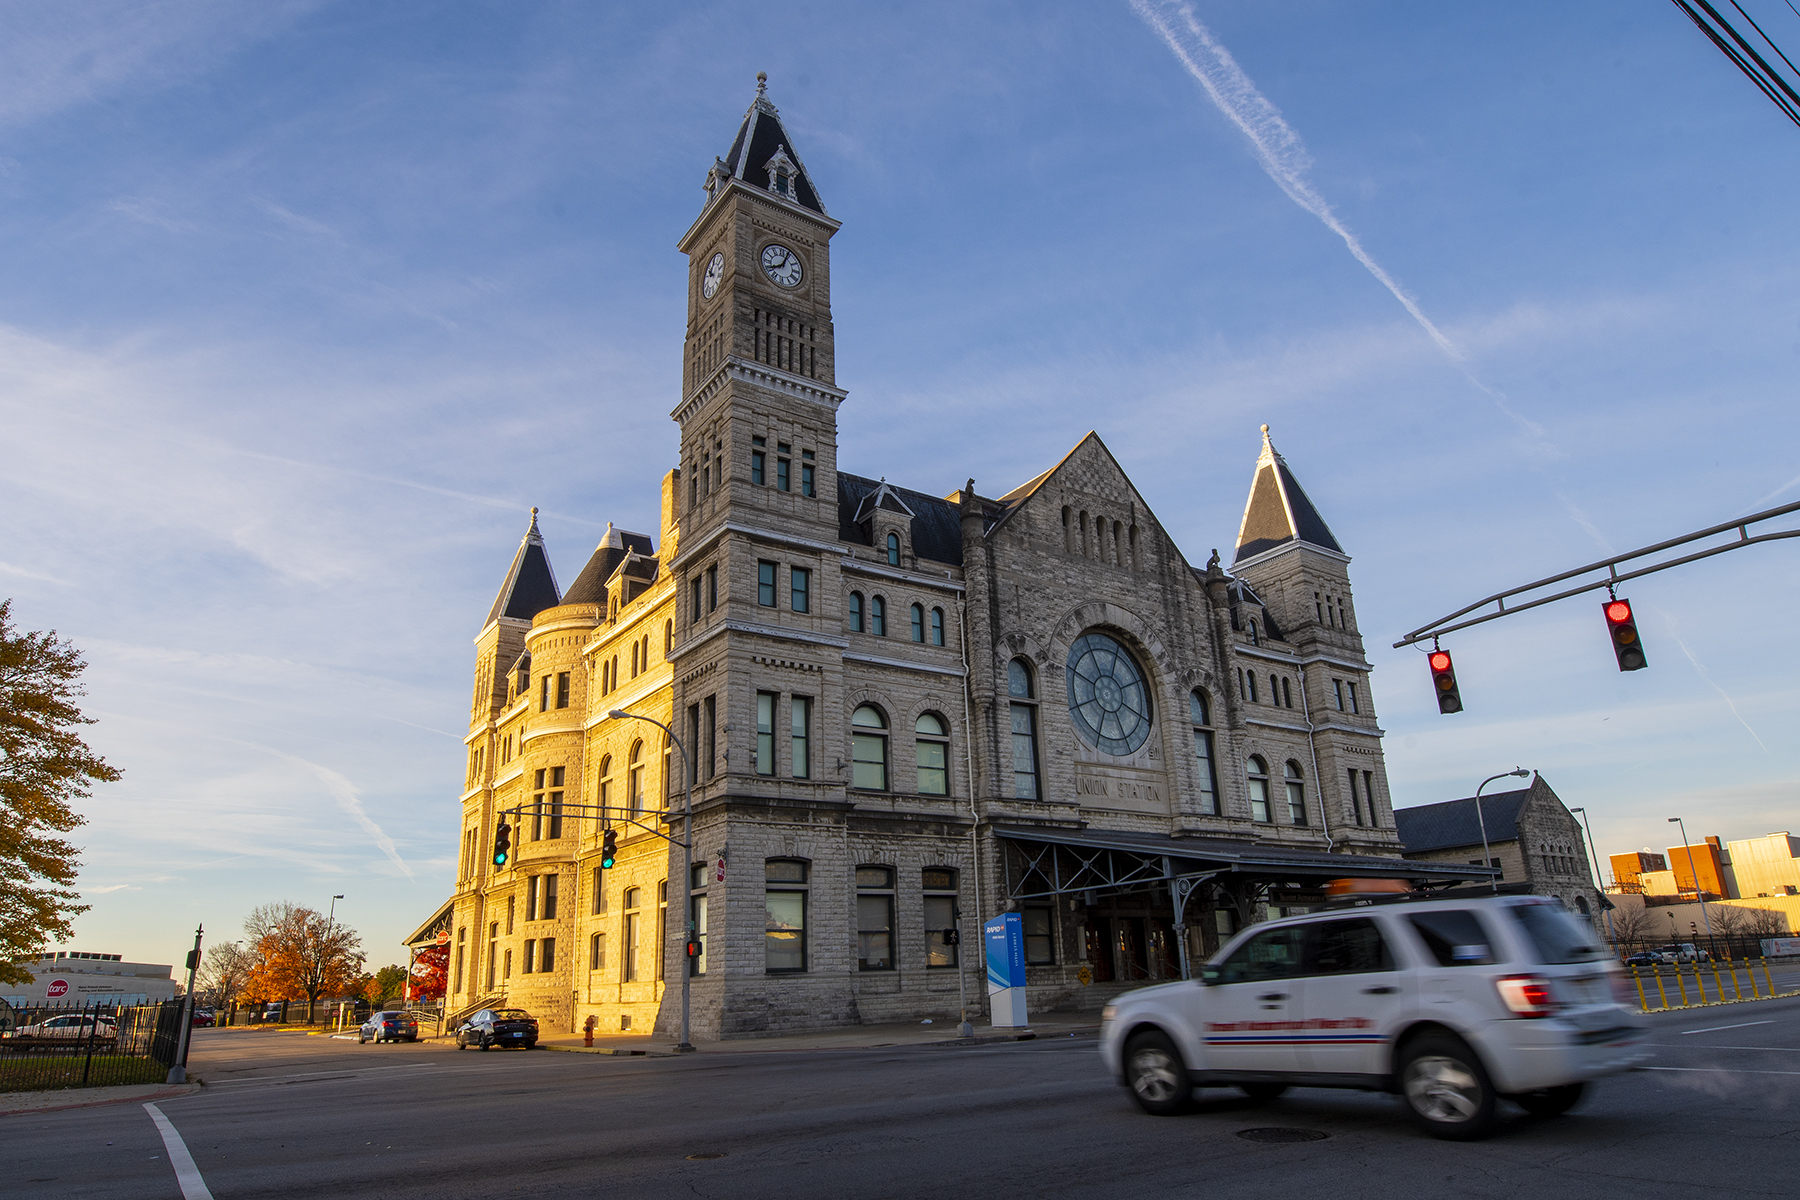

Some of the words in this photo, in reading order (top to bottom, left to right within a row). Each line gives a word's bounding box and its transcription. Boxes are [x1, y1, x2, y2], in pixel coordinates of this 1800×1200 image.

[1075, 776, 1109, 797] UNION
[1117, 782, 1160, 801] STATION
[48, 985, 67, 993] tarc
